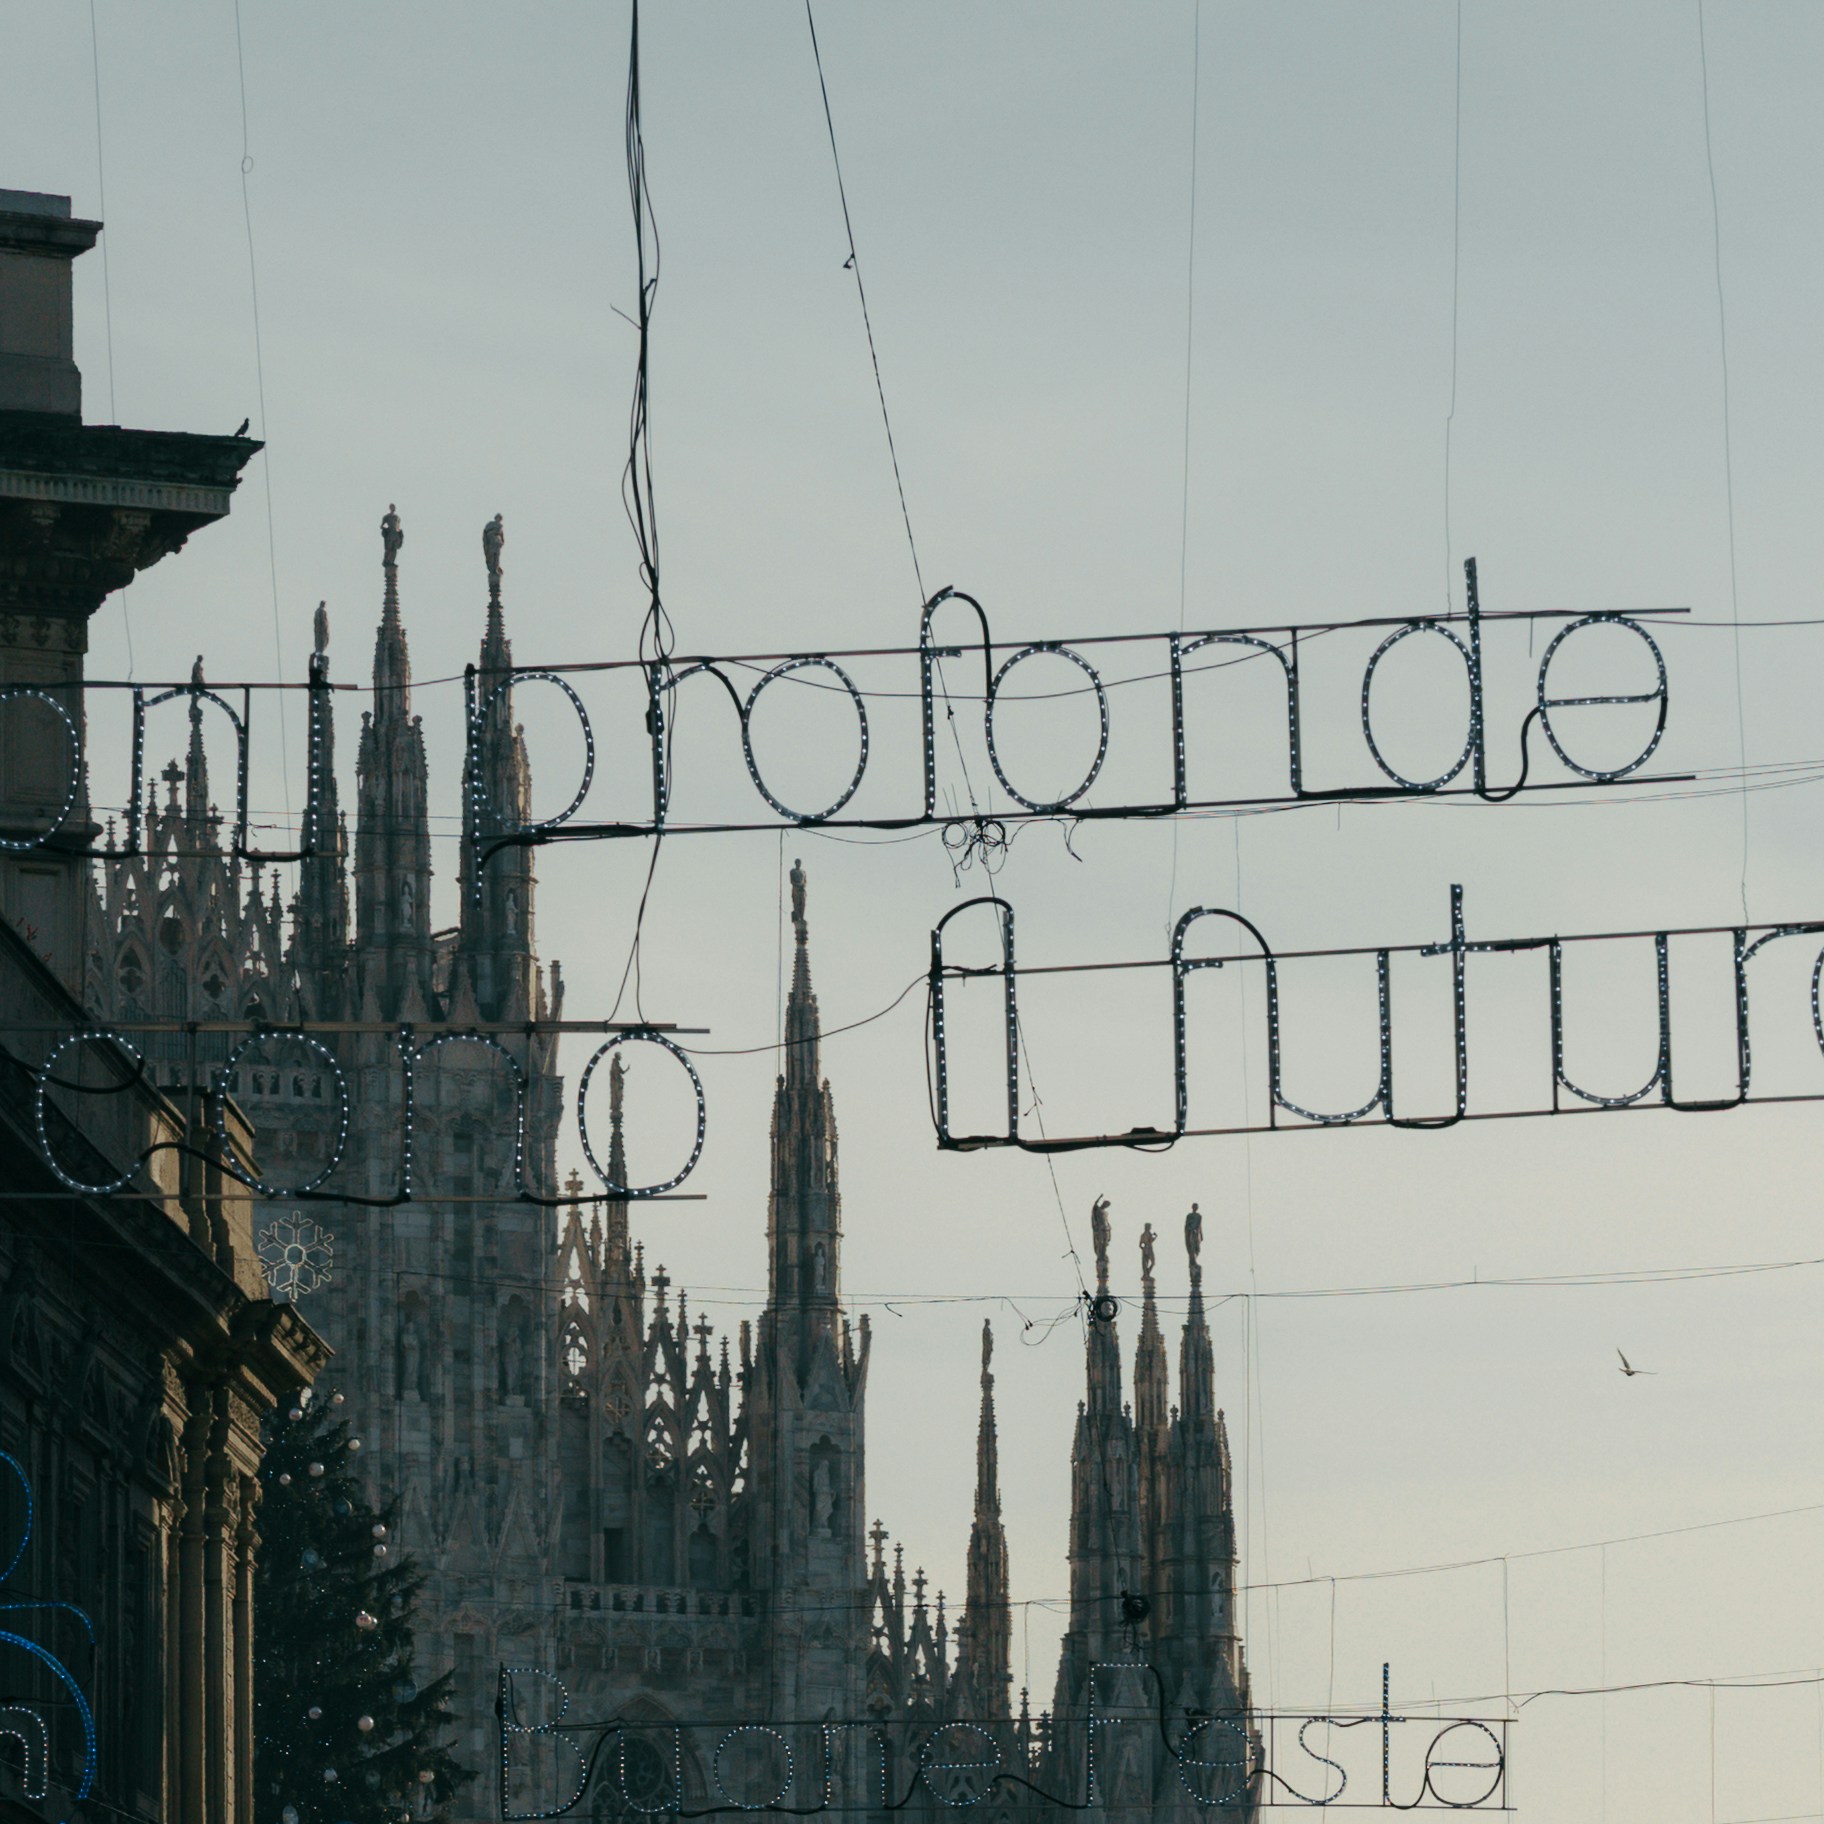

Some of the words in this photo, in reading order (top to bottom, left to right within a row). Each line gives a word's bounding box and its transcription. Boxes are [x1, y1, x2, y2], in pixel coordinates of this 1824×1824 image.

[464, 559, 1668, 908] profonde
[501, 1664, 1001, 1820] Buone
[1088, 1662, 1505, 1809] Feste
